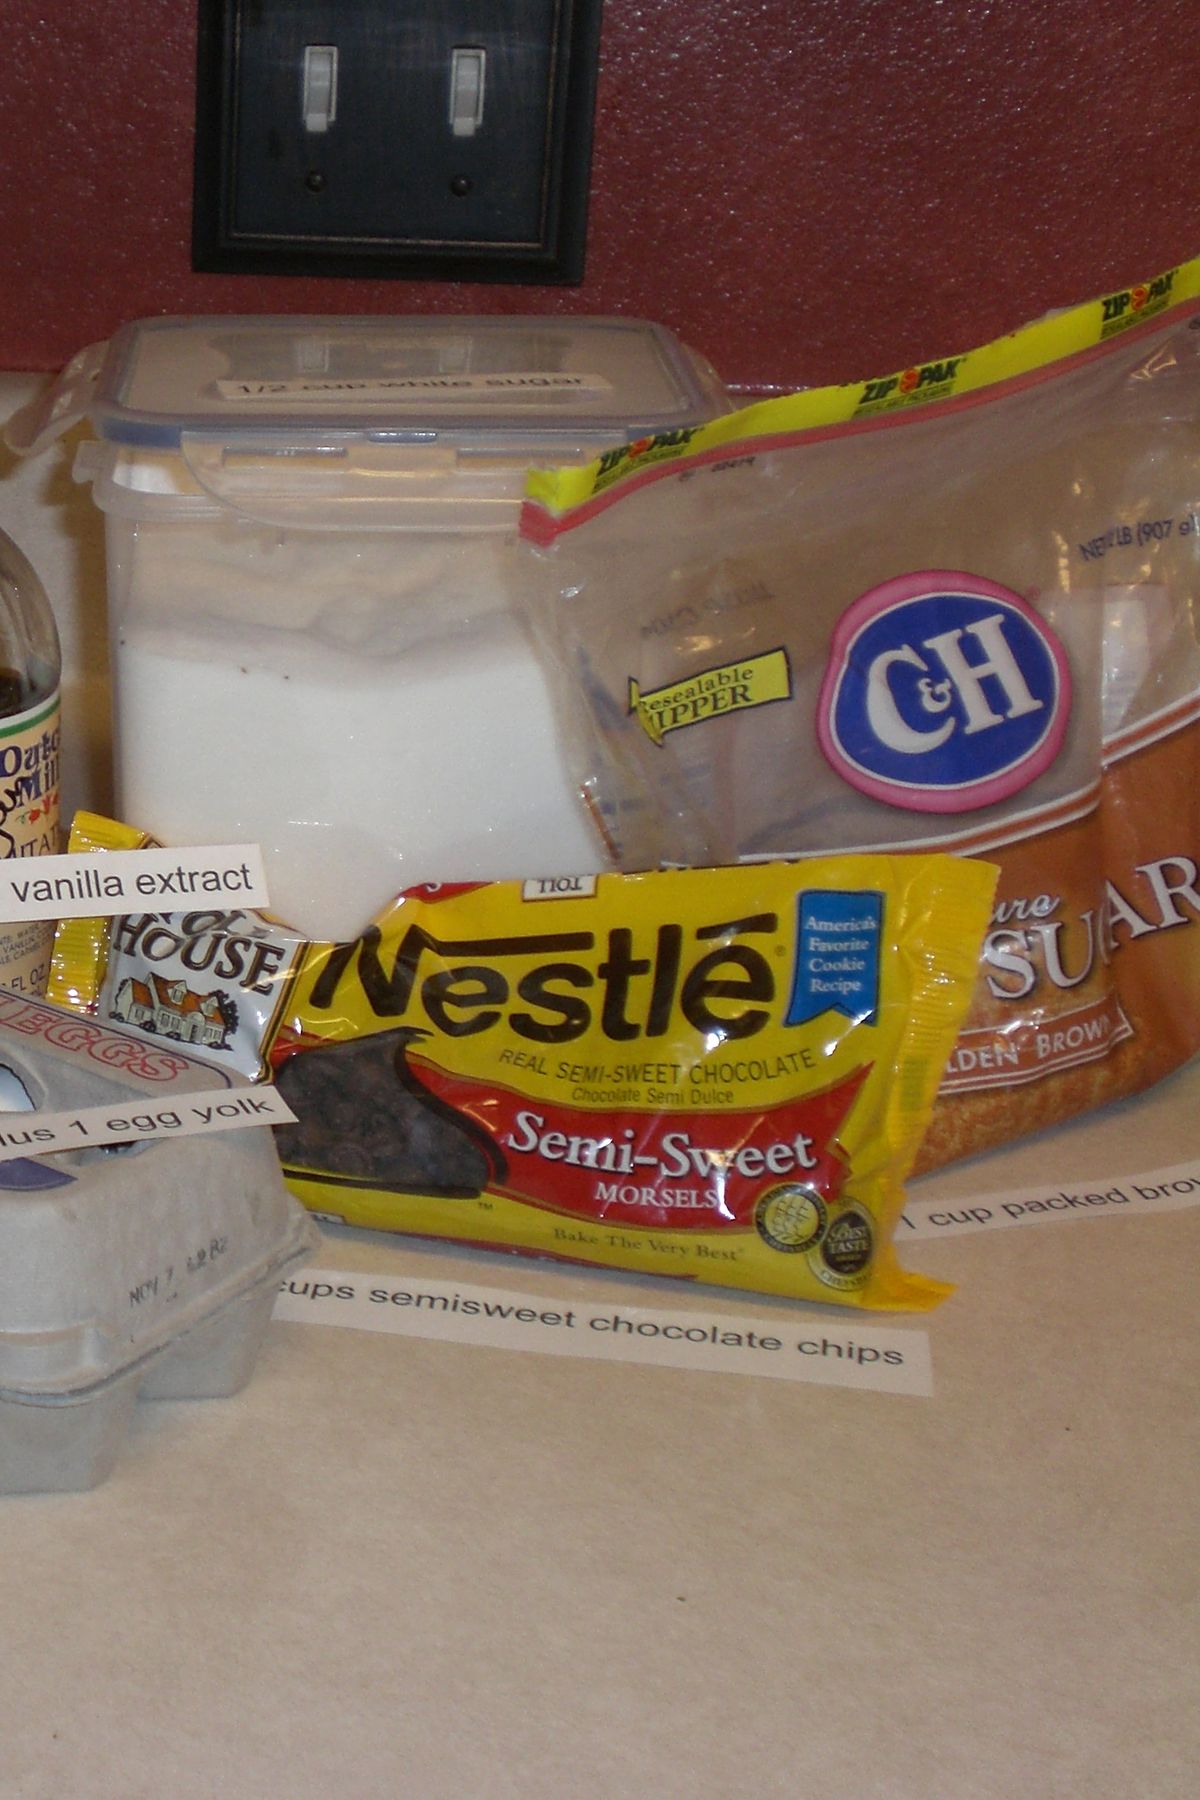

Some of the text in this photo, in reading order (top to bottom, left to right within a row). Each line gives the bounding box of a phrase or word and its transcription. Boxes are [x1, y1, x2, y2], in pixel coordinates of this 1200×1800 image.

[236, 376, 585, 395] 1/2 cup white sugar
[650, 684, 753, 730] IPPER
[11, 868, 125, 903] vanilla
[136, 862, 254, 898] extract
[982, 856, 1200, 1000] SUAR
[992, 894, 1060, 923] ure
[113, 913, 286, 996] HOUSE
[808, 937, 869, 952] Favorite
[308, 911, 778, 1045] Nestlé
[809, 957, 865, 972] Cookie
[810, 978, 862, 995] Recipe
[0, 998, 189, 1082] EGGS
[499, 1048, 817, 1085] REAL SEMI-SWEET CHOCOLATE
[572, 1086, 734, 1105] Chocolate Semi Dulce
[68, 1120, 89, 1136] 1
[106, 1106, 182, 1134] egg
[193, 1096, 276, 1126] yolk
[507, 1109, 818, 1179] Semi-Sweet
[594, 1181, 718, 1209] MORSELS
[928, 1206, 993, 1226] cup
[1001, 1187, 1131, 1219] packed
[553, 1226, 738, 1262] Bake The Very Best
[369, 1287, 575, 1328] semisweet
[589, 1314, 784, 1352] chocolate
[797, 1337, 905, 1366] chips
